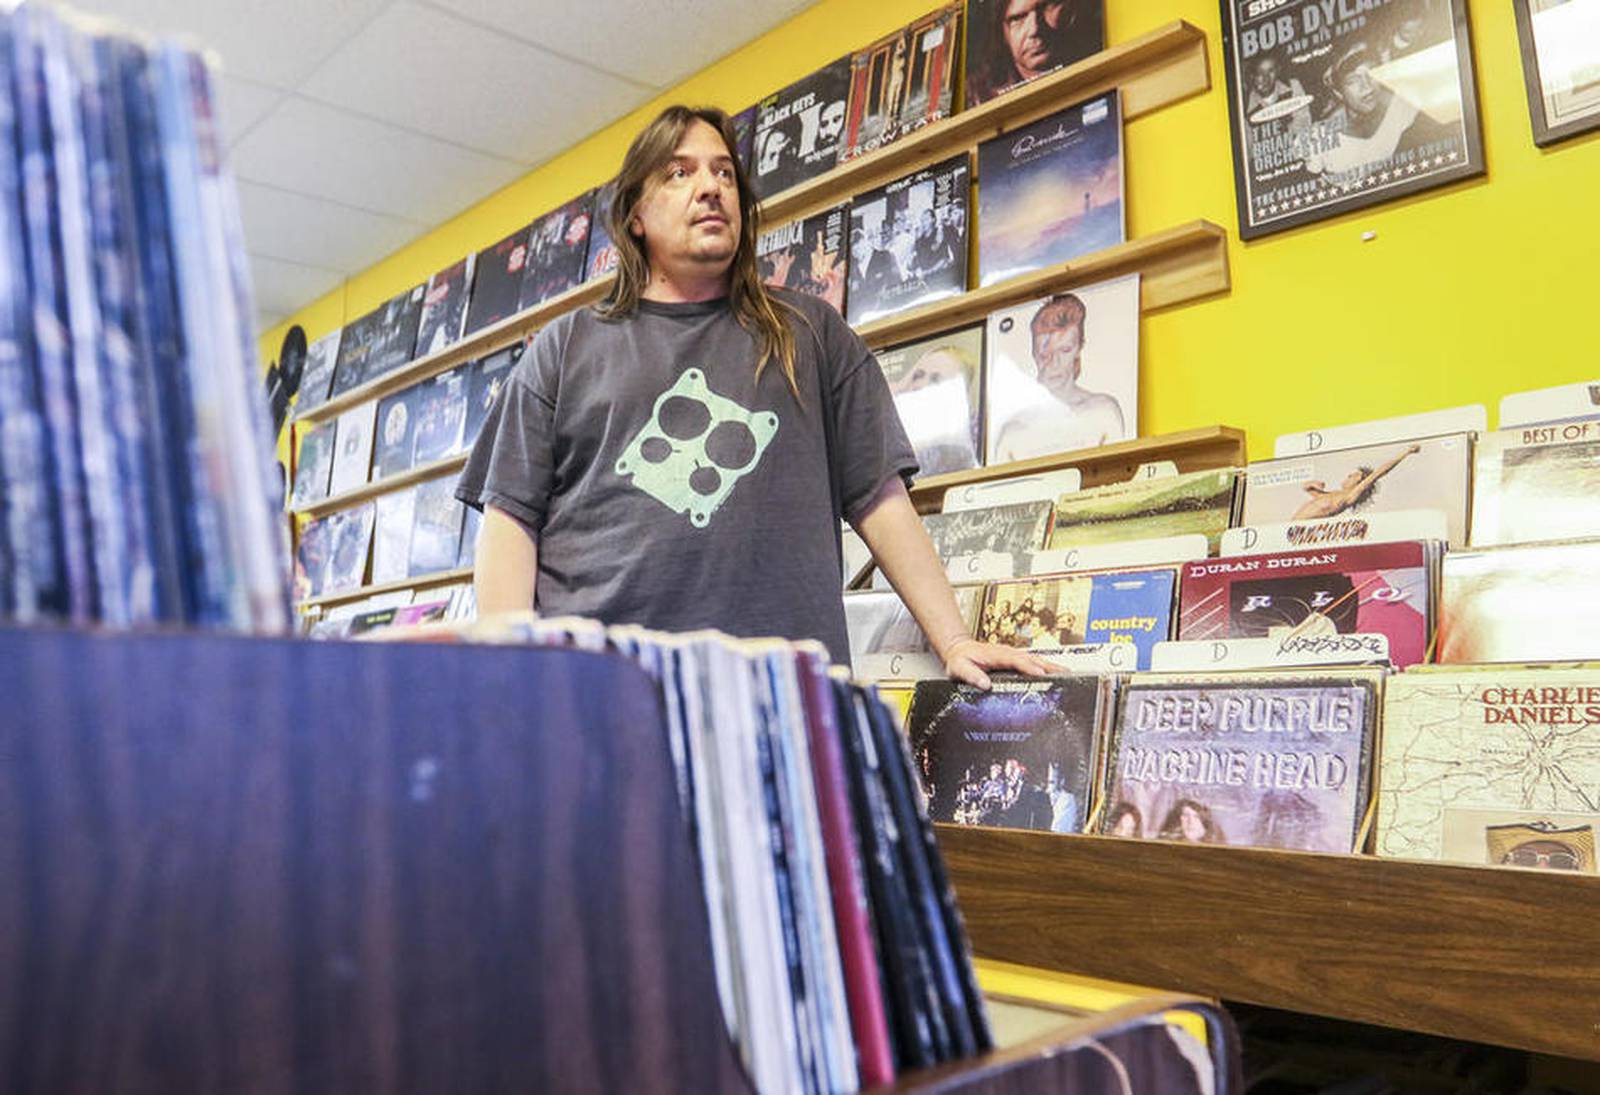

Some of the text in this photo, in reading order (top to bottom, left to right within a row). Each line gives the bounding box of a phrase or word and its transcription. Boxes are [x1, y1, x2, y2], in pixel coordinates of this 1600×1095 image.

[1242, 15, 1295, 58] BOB
[1307, 431, 1323, 451] D
[1523, 428, 1556, 444] BEST
[1241, 527, 1258, 549] D
[1190, 553, 1338, 578] DURAN DURAN
[1090, 616, 1159, 633] country
[1213, 641, 1228, 660] D
[1482, 686, 1600, 705] CHARLIE
[1135, 694, 1352, 734] DEEP PURPLE
[1484, 705, 1600, 724] DANIELS
[1123, 746, 1349, 791] MACHINE HEAD
